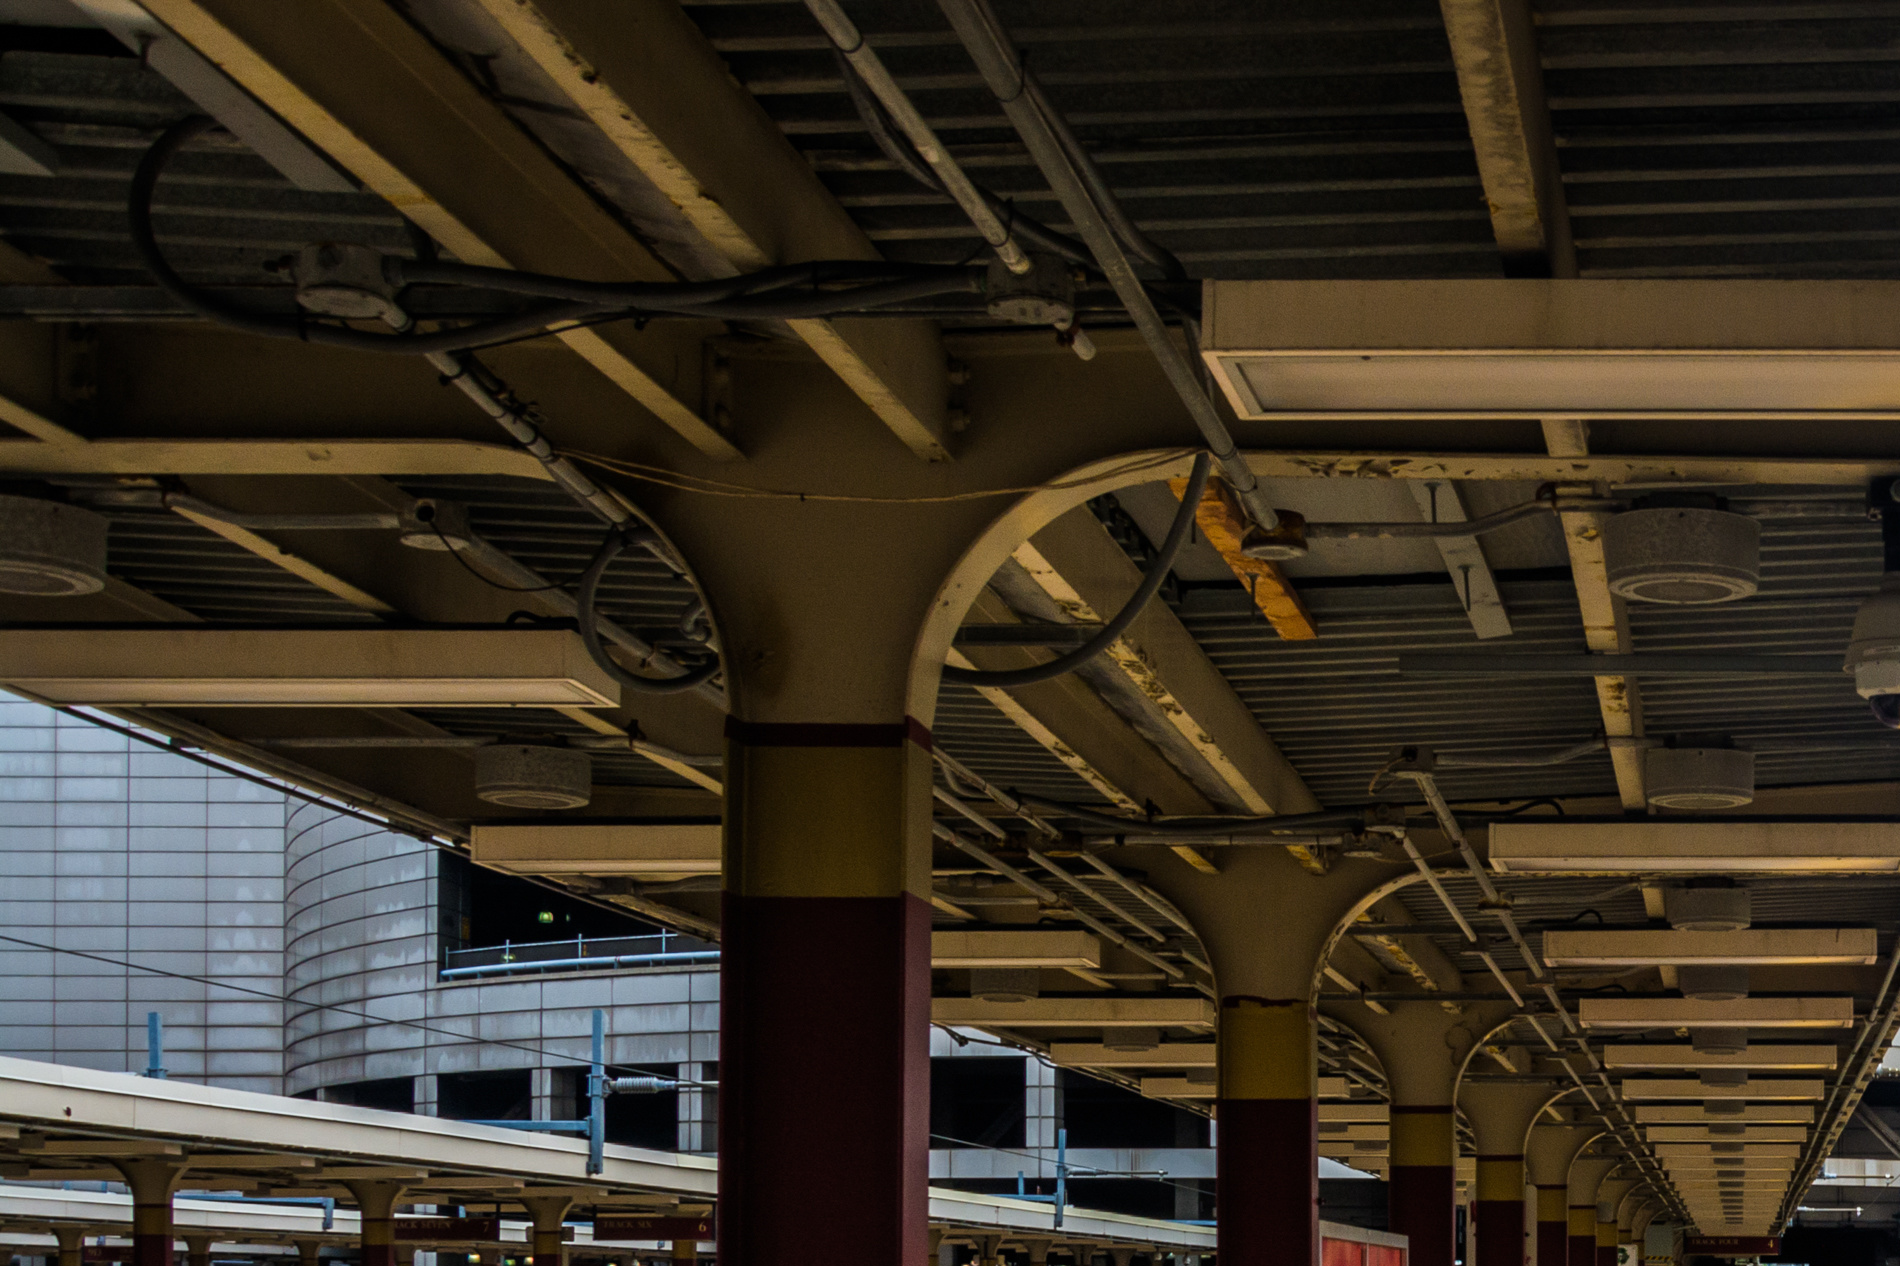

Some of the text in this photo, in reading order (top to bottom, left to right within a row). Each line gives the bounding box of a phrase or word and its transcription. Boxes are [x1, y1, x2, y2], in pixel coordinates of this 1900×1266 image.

[483, 1221, 490, 1232] 7
[603, 1221, 633, 1229] TRACK
[698, 1220, 707, 1233] 6
[1768, 1239, 1774, 1248] 4
